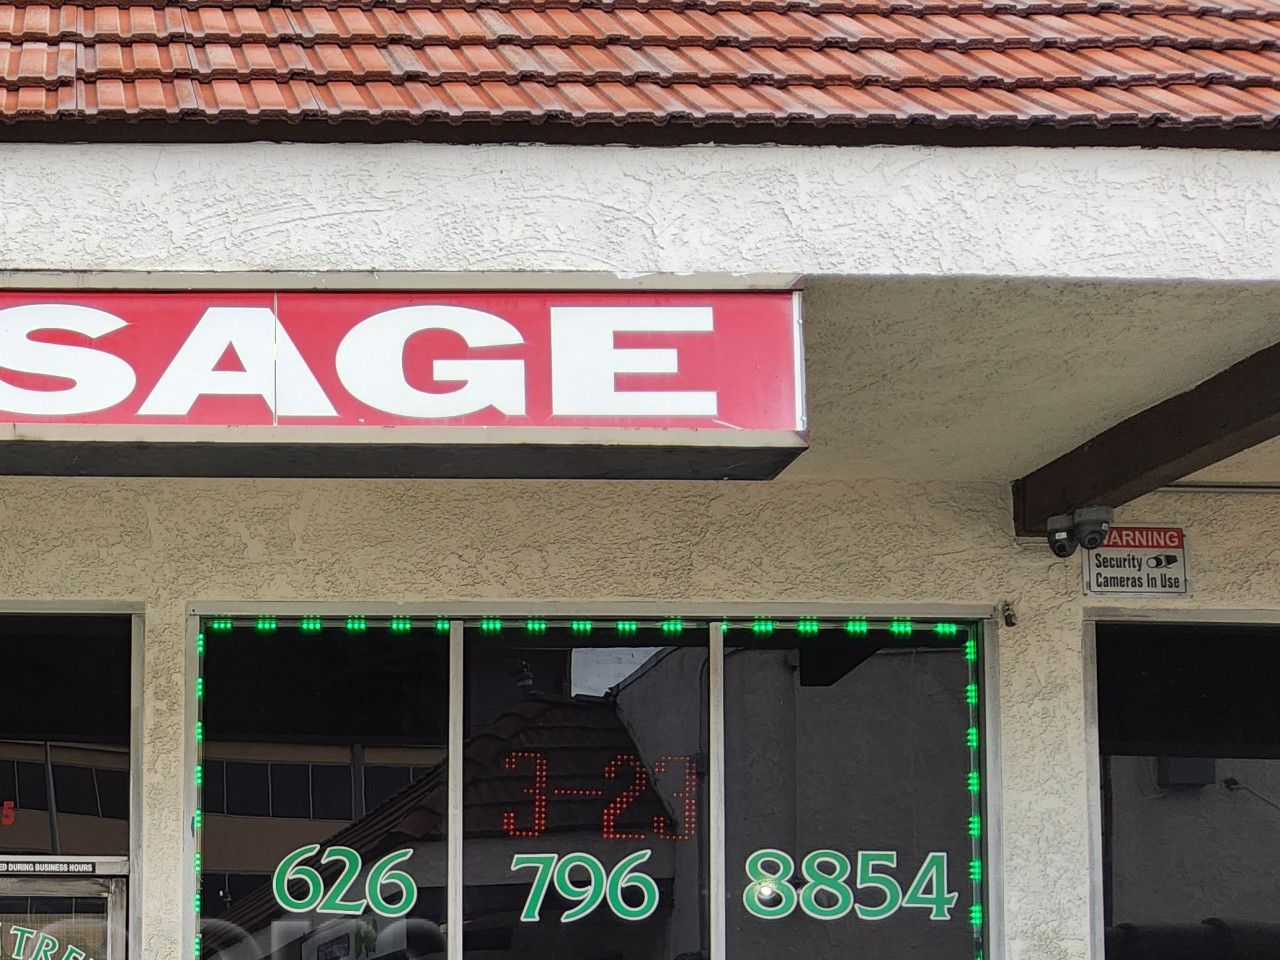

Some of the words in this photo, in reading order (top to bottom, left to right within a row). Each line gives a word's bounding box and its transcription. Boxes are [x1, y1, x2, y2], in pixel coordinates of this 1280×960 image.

[1095, 553, 1143, 571] Security
[1096, 573, 1143, 588] Cameras
[1147, 573, 1157, 588] In
[1161, 573, 1180, 589] Use
[8, 863, 34, 871] DURING
[69, 864, 93, 872] HOURS
[273, 844, 418, 918] 626
[511, 850, 660, 922] 796
[743, 848, 959, 921] 8854
